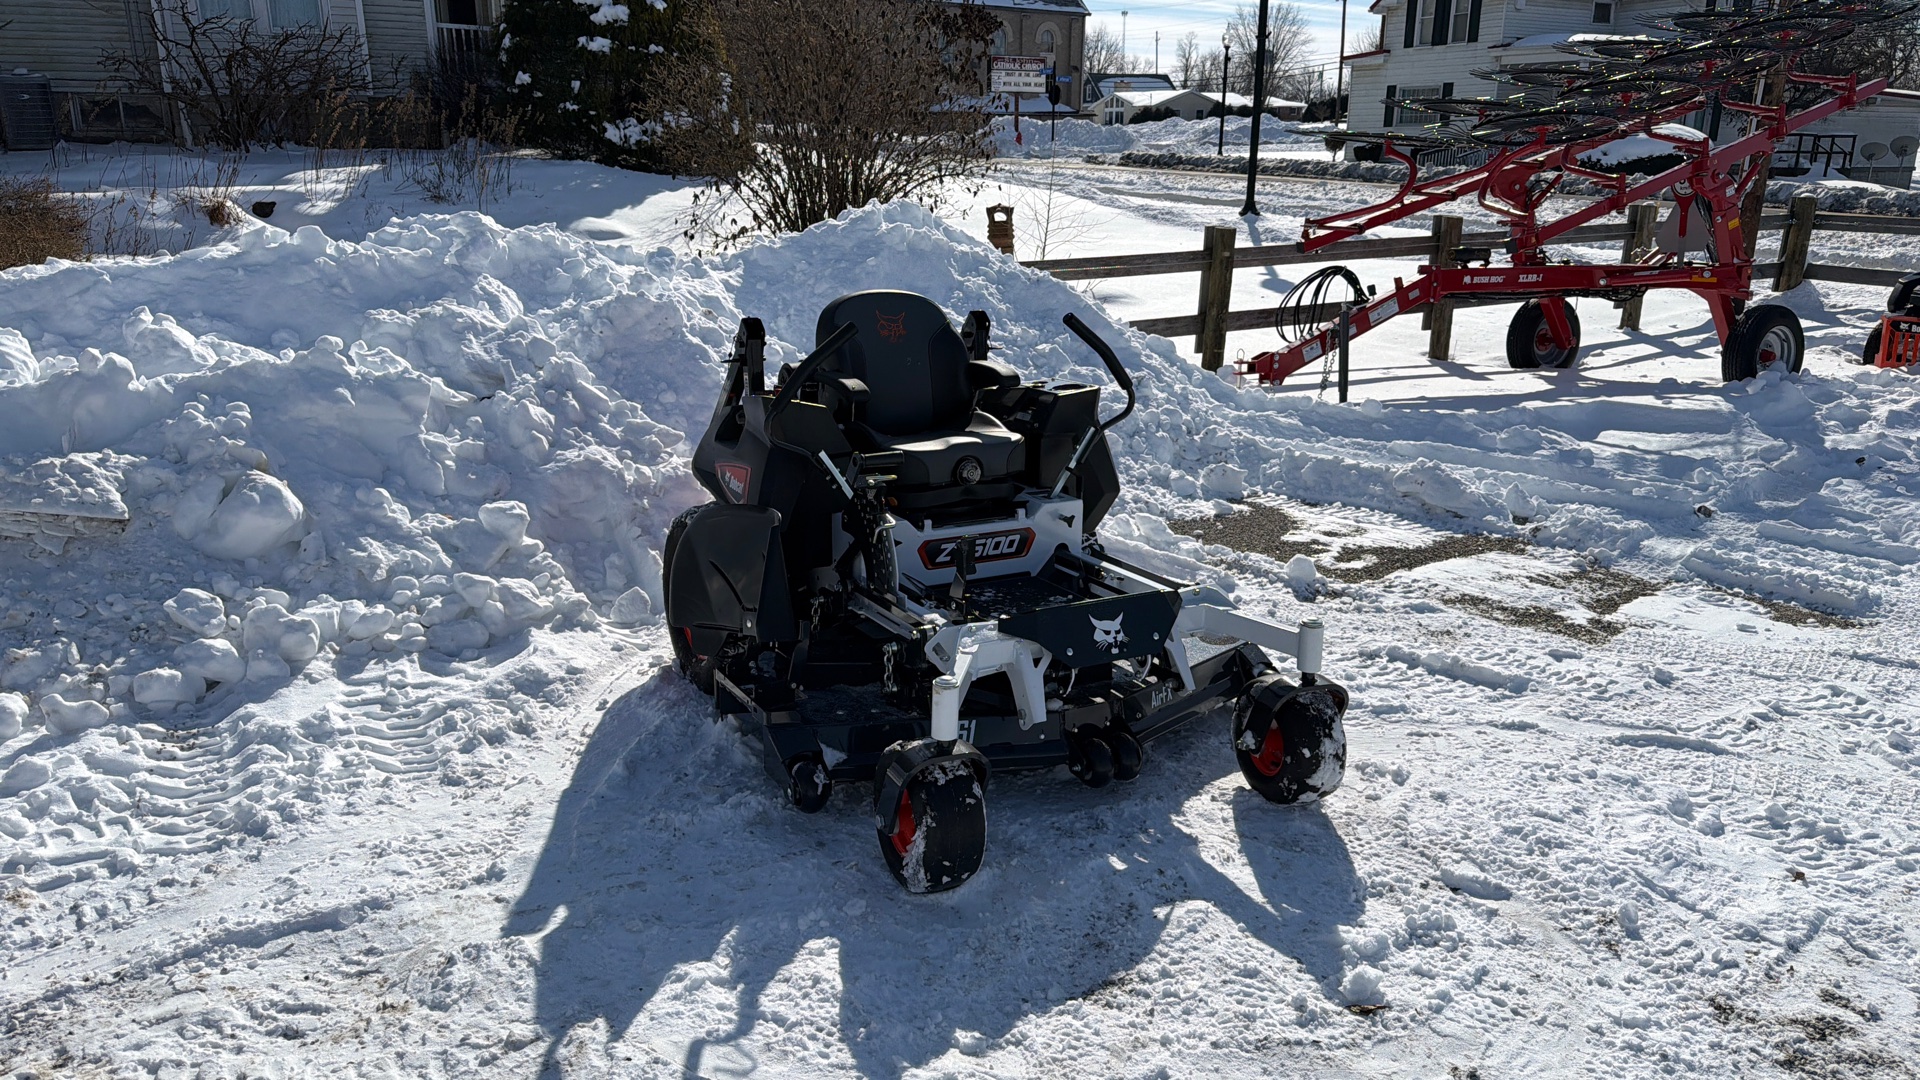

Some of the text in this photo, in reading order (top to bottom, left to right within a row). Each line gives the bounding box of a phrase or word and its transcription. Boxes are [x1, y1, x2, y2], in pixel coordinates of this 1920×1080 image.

[993, 60, 1045, 70] CATHOLIC CHURCH
[1472, 275, 1504, 284] BUSH HOG
[1151, 686, 1173, 709] AirFX
